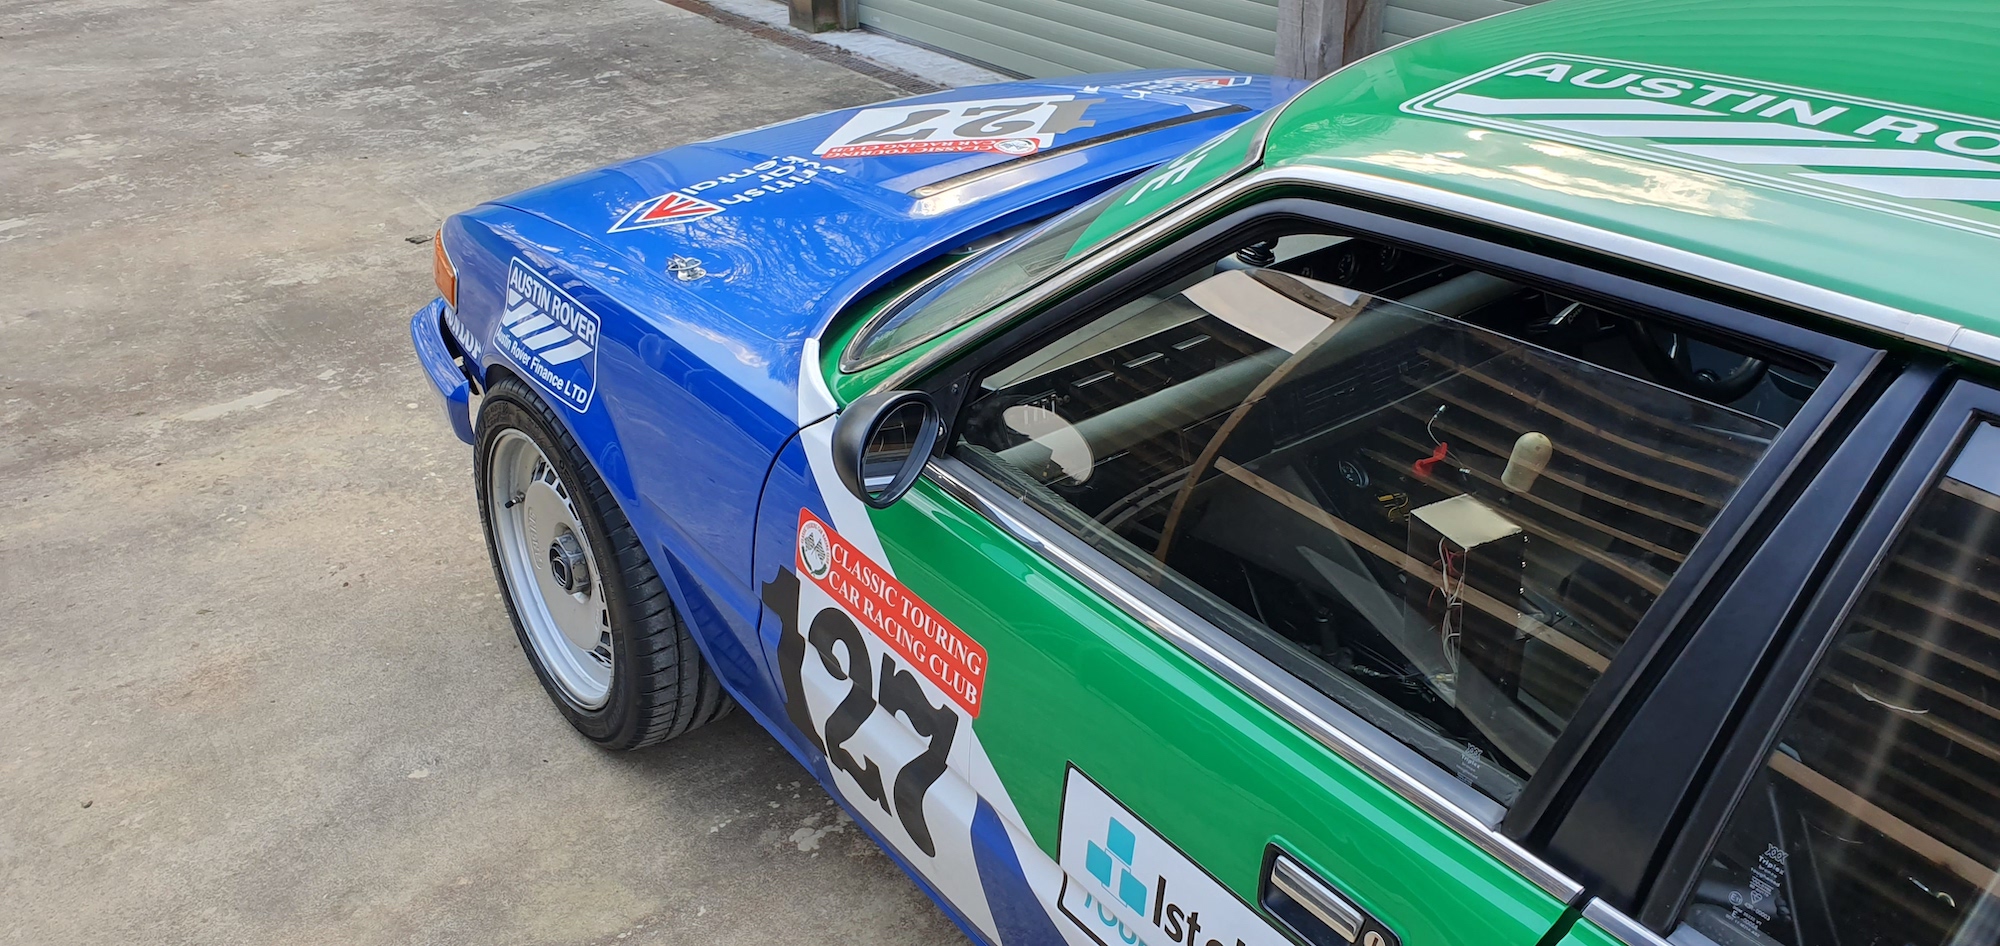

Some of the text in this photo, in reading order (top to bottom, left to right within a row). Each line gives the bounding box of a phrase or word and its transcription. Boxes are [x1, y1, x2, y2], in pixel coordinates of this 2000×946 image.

[845, 98, 1107, 146] 127
[1504, 62, 1852, 127] AUSTIN
[510, 265, 597, 346] AUSTIN ROVER
[511, 340, 531, 367] Rover
[530, 355, 563, 390] Finance
[563, 380, 588, 405] LTD
[828, 570, 978, 706] CAR RACING CLUB
[830, 542, 898, 608] CLASSIC
[900, 596, 982, 677] TOURING
[761, 564, 959, 858] 127
[1758, 855, 1785, 876] Triplex
